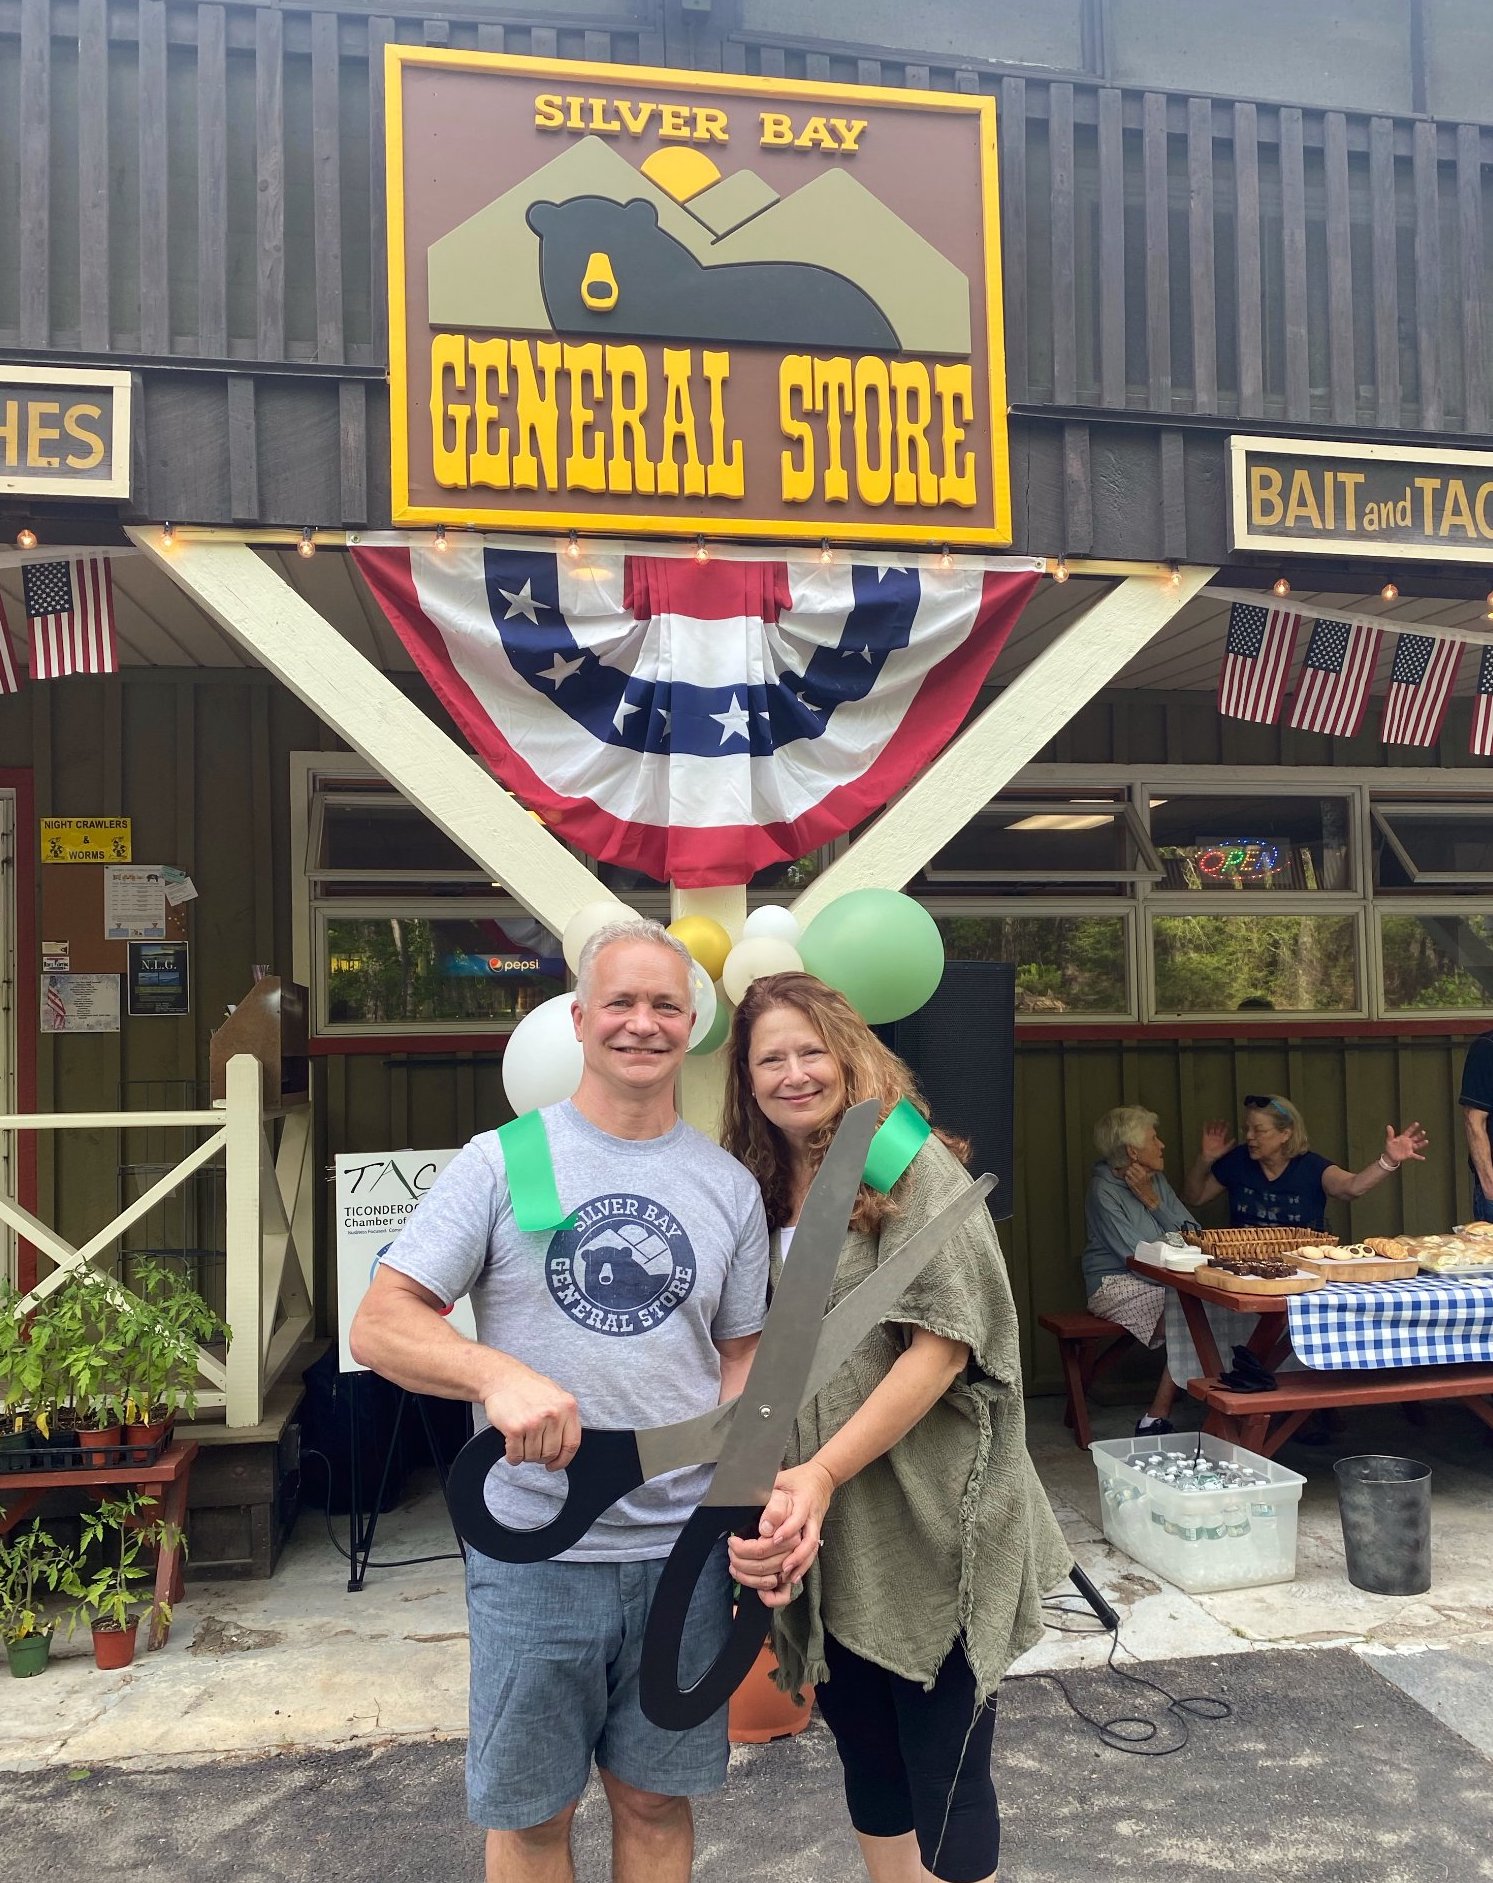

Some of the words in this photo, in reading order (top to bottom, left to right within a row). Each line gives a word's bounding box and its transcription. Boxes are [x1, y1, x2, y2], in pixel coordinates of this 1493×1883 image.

[535, 93, 729, 141] SILVER
[759, 111, 867, 154] BAY
[429, 333, 745, 499] GENERAL
[779, 354, 978, 507] STORE
[1250, 466, 1365, 531] BAIT
[1363, 486, 1412, 532] and
[44, 820, 73, 829] NIGHT
[75, 820, 128, 829] CRAWLERS
[83, 836, 90, 844] &
[69, 850, 105, 860] WORMS
[1199, 851, 1277, 872] OPEN
[504, 959, 539, 971] pepsi
[344, 1217, 393, 1228] Chamber
[397, 1217, 407, 1225] of
[573, 1199, 638, 1233] SILVER
[642, 1204, 683, 1239] BAY
[550, 1257, 634, 1333] GENERAL
[638, 1265, 693, 1327] STORE
